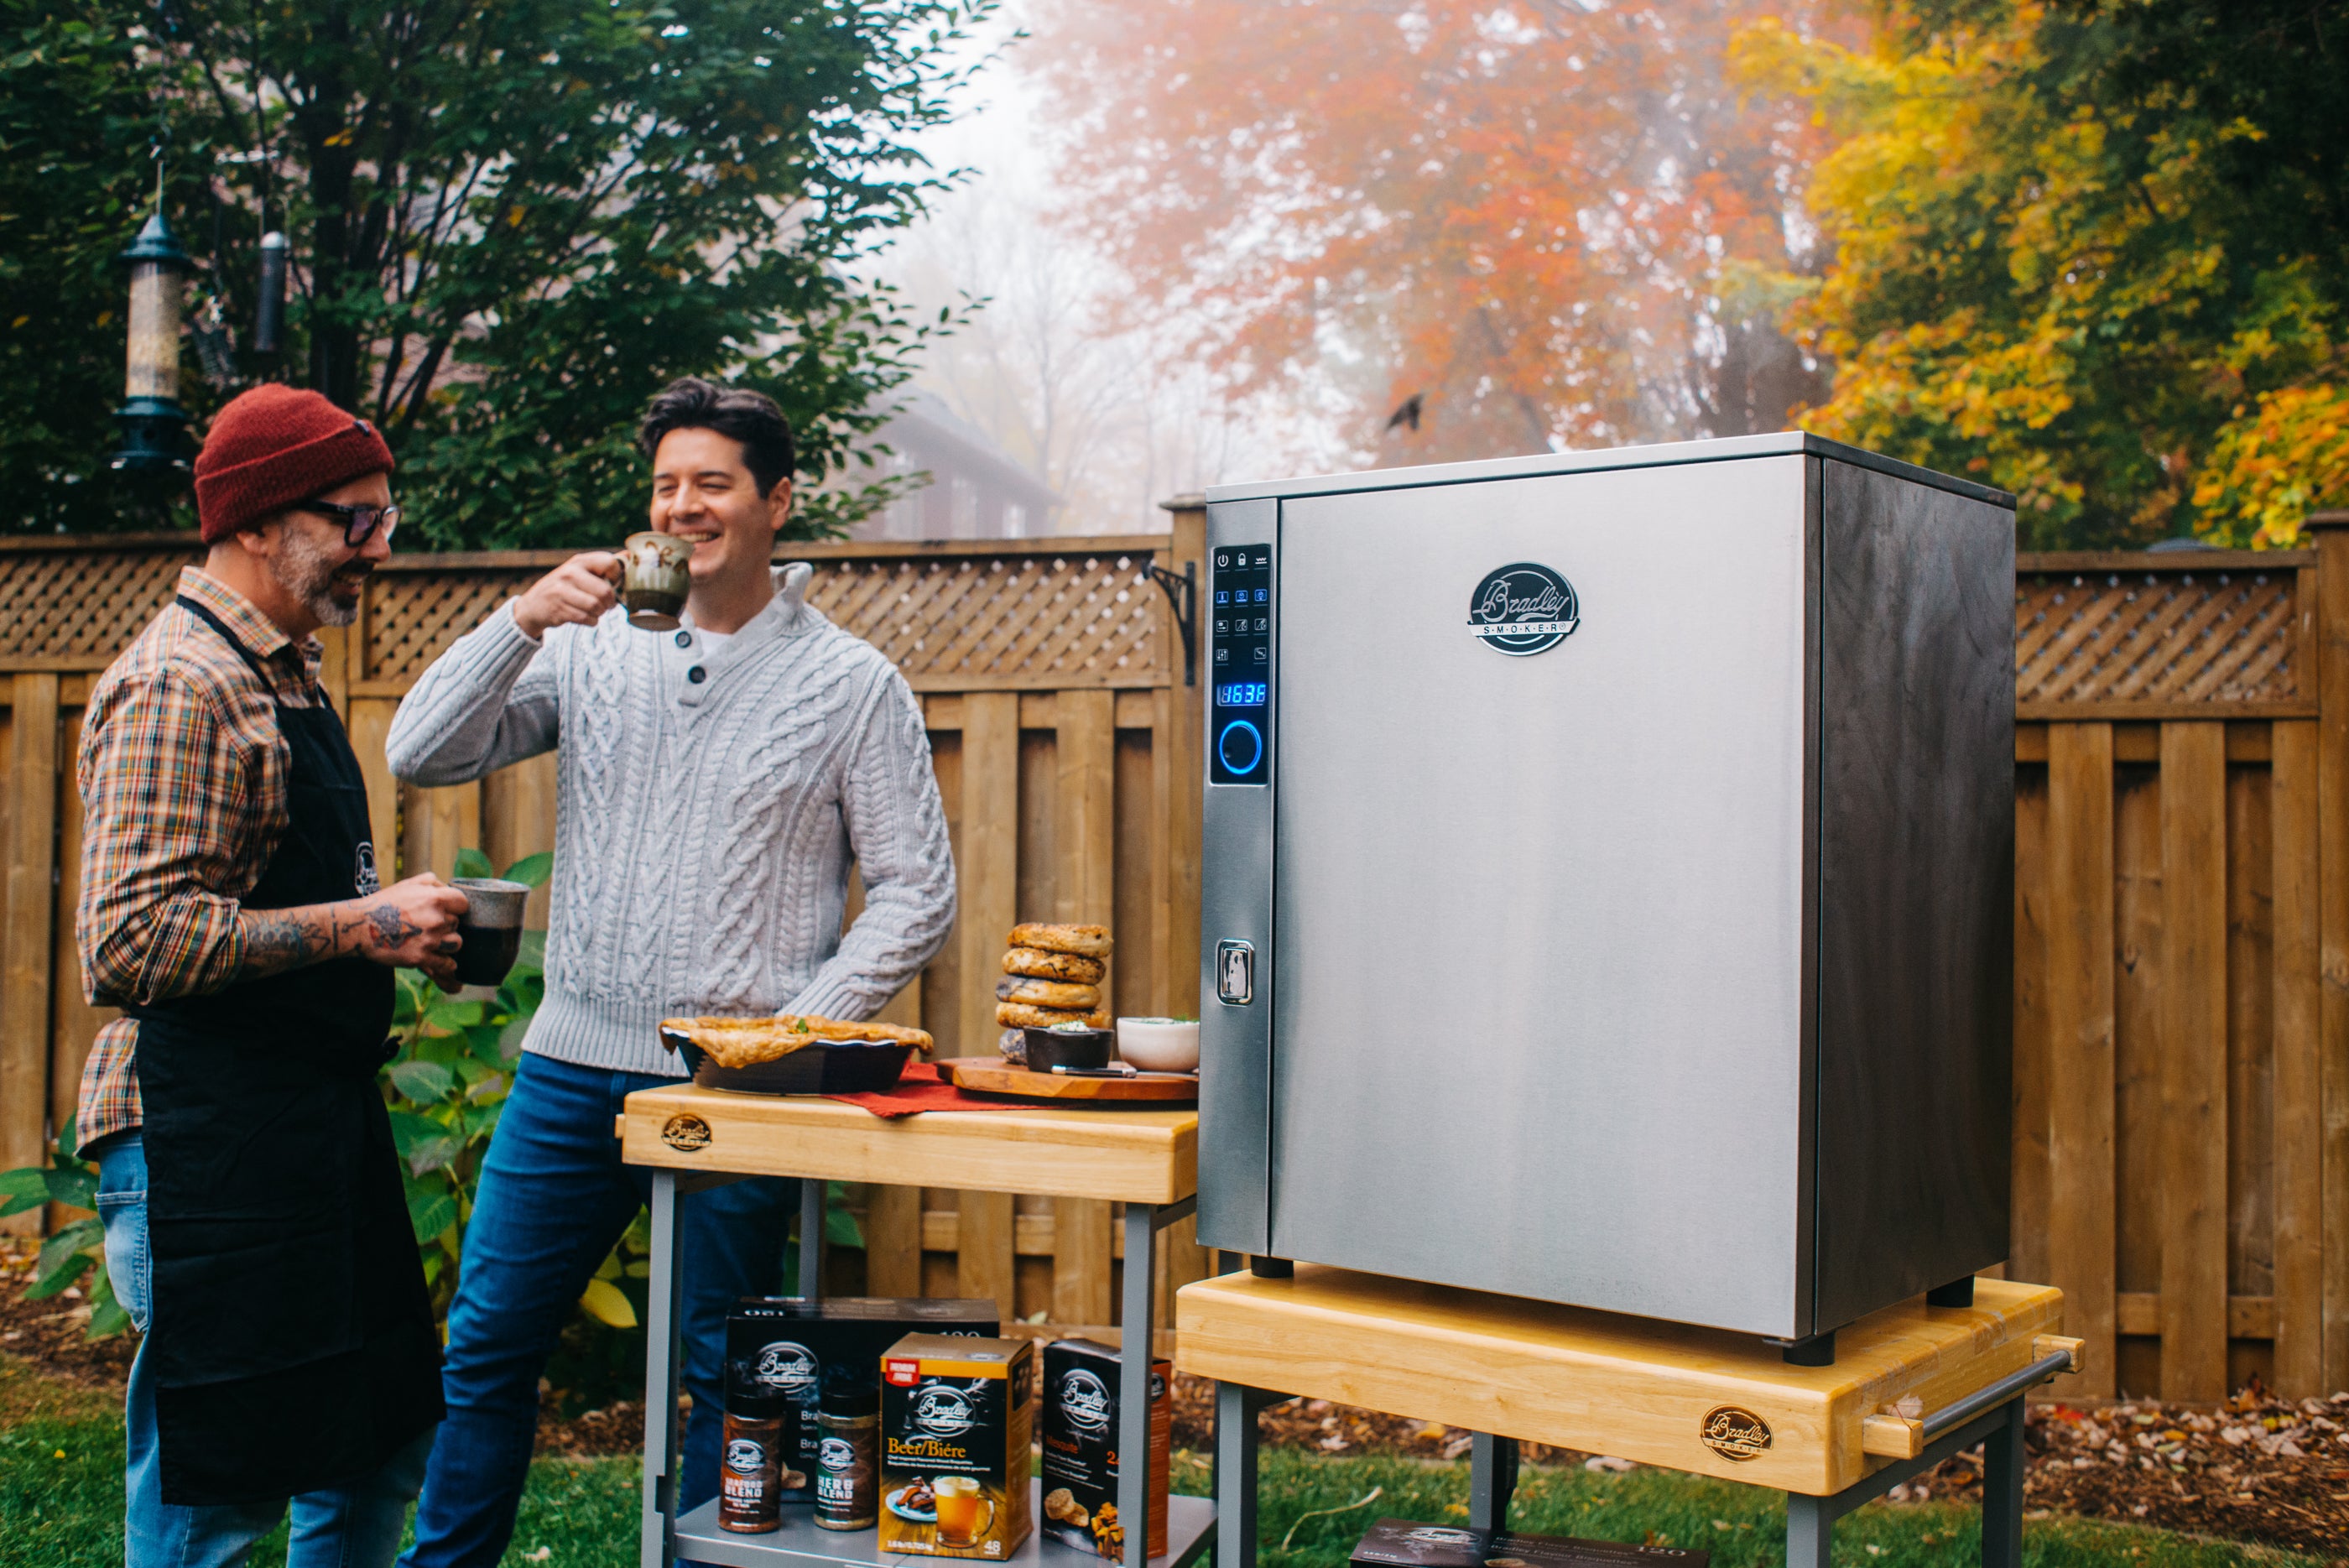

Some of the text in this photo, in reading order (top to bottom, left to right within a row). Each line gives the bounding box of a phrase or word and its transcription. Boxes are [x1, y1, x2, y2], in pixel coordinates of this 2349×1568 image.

[1472, 579, 1570, 623] Bradley
[914, 1394, 973, 1420] Bradley
[1060, 1378, 1108, 1412] Bradley
[1705, 1414, 1770, 1447] Bradley
[818, 1475, 854, 1490] HERB
[818, 1487, 853, 1499] BLEND
[984, 1540, 1001, 1552] 48
